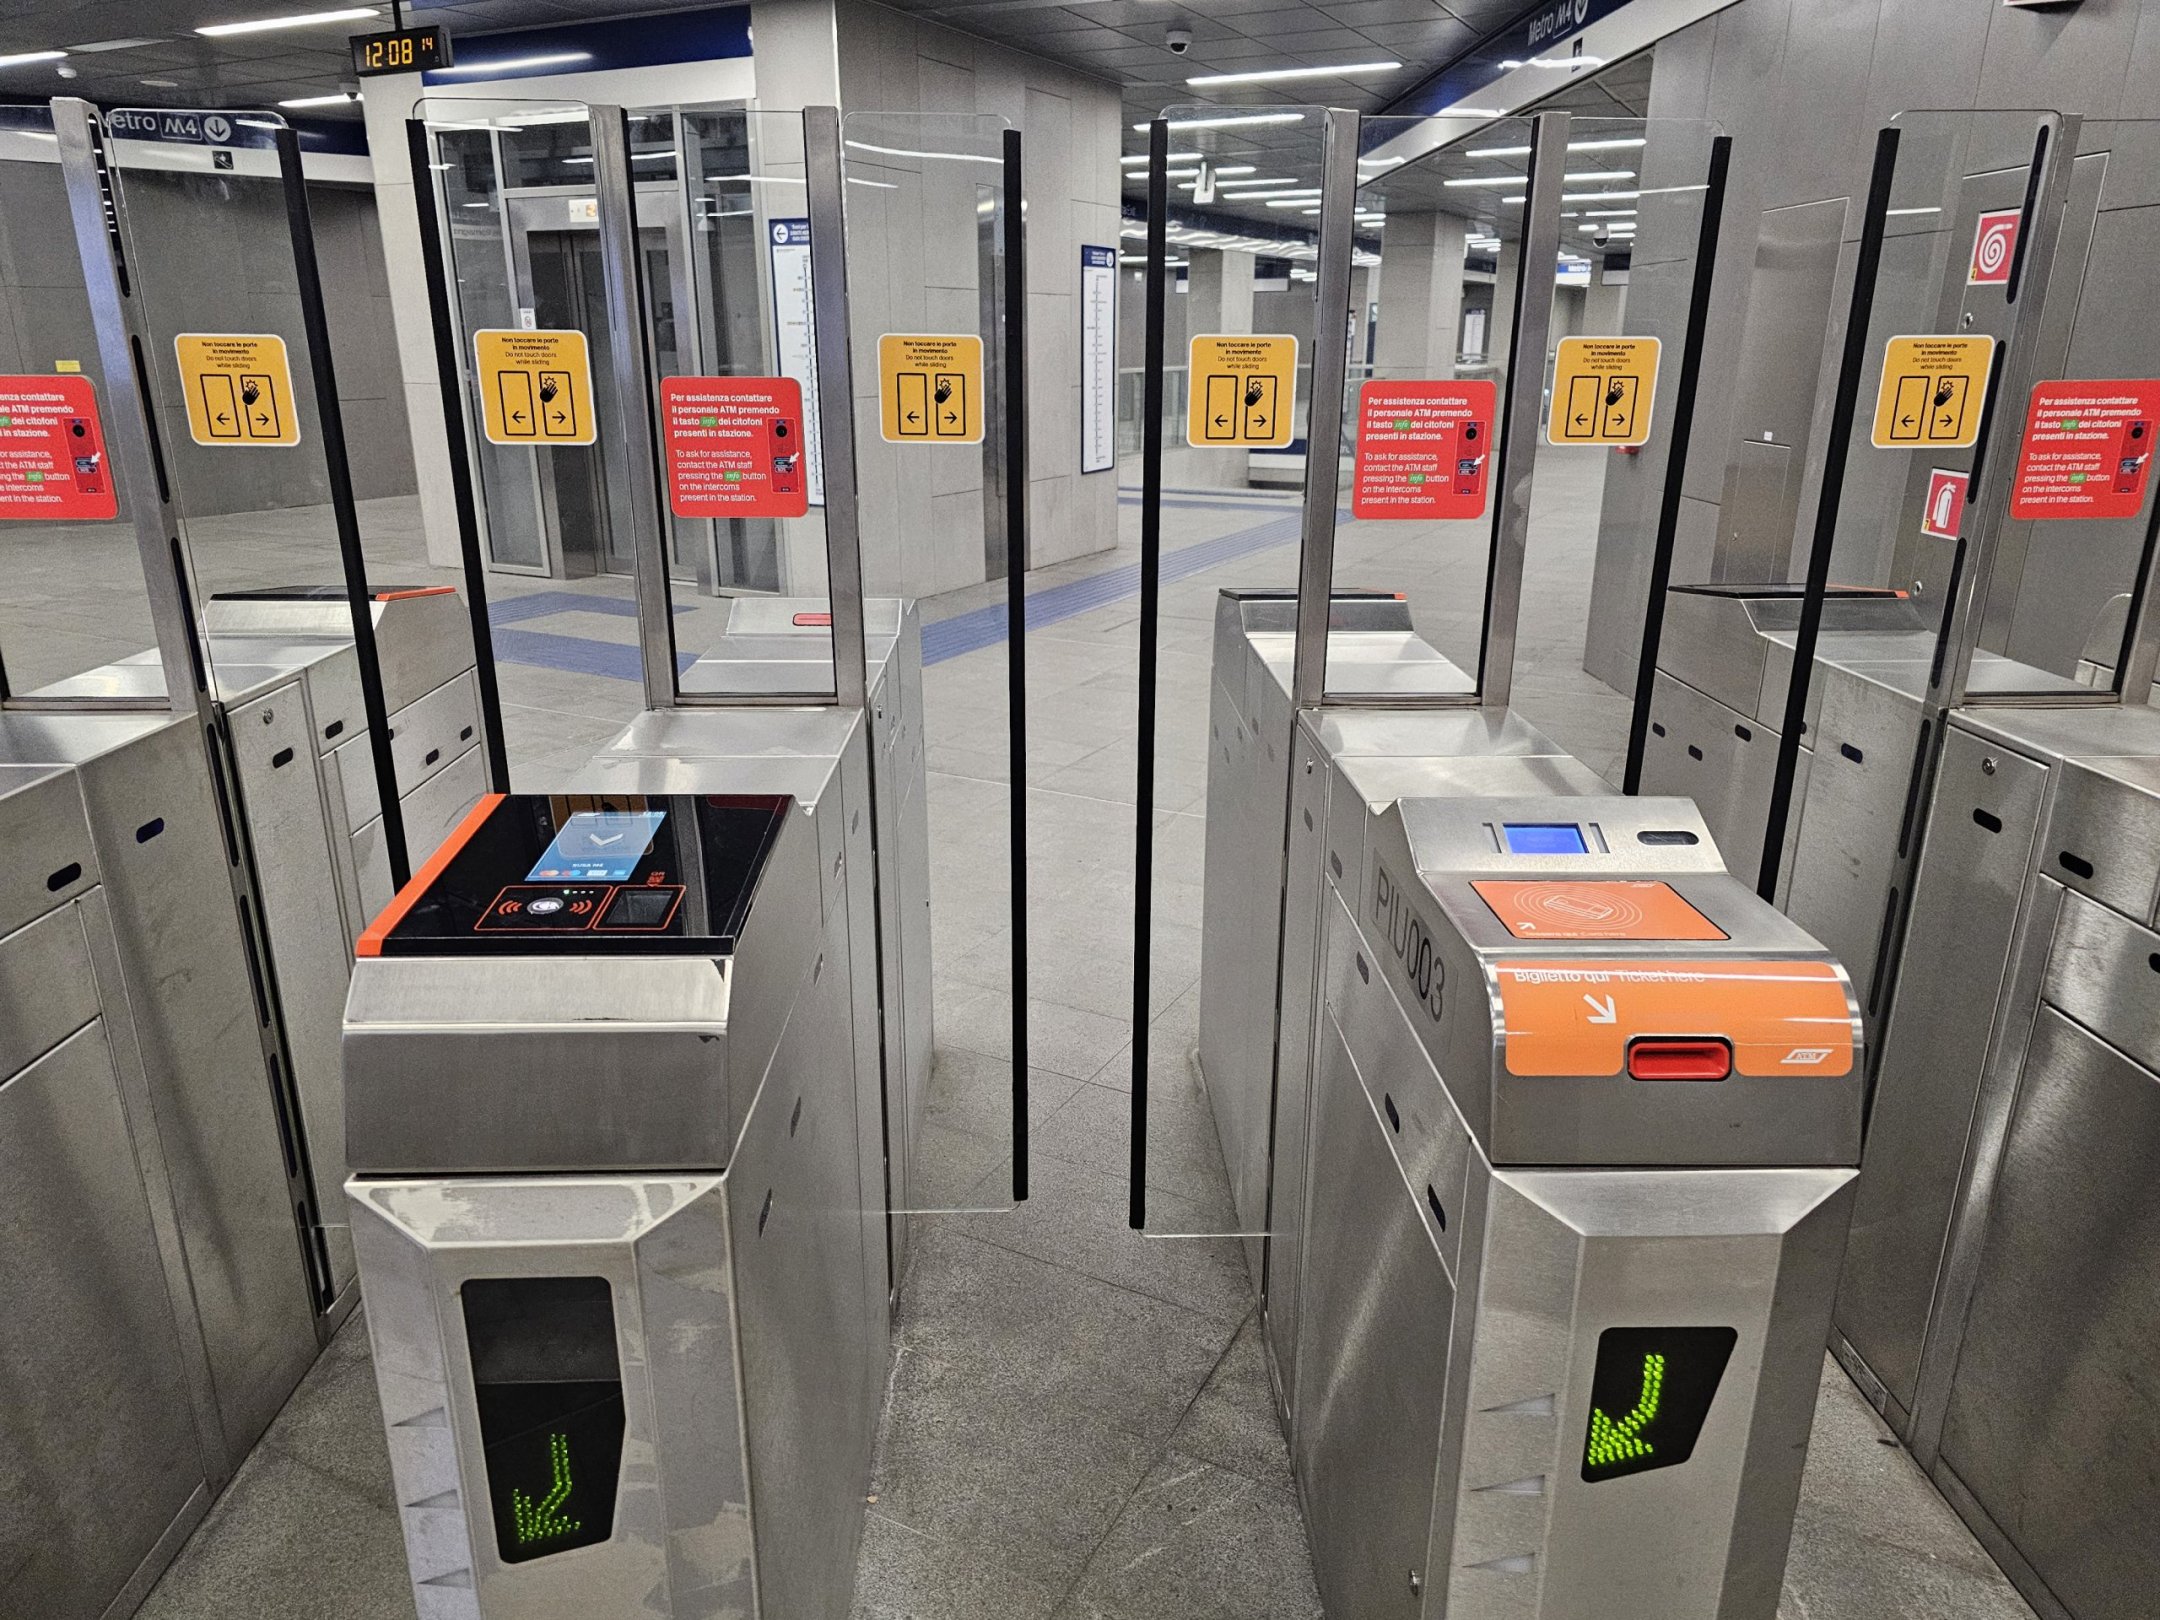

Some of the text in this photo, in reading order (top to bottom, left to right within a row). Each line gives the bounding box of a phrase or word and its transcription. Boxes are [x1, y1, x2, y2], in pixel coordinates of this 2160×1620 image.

[1528, 12, 1554, 46] Metro
[422, 37, 433, 51] 14
[164, 118, 197, 135] M4
[21, 393, 65, 401] contattare
[671, 393, 772, 402] Per assistenza contattare
[1368, 397, 1467, 406] Per assistenza contattare
[2039, 397, 2139, 406] Per assistenza contattare
[12, 405, 29, 413] ATM
[31, 405, 74, 414] premendo
[678, 406, 718, 414] personale
[738, 406, 779, 414] premendo
[1373, 409, 1413, 418] personale
[1413, 409, 1431, 417] ATM
[1432, 409, 1472, 418] premendo
[2037, 409, 2042, 417] il
[2042, 409, 2082, 418] personale
[2100, 409, 2142, 418] premendo
[732, 418, 762, 426] citofoni
[1410, 421, 1422, 429] dei
[1424, 421, 1454, 429] citofoni
[2092, 420, 2122, 428] citofoni
[4, 429, 50, 437] in stazione.
[674, 429, 707, 438] presenti
[1366, 432, 1398, 441] presenti
[1400, 432, 1407, 440] in
[2032, 432, 2065, 442] presenti
[2066, 432, 2073, 440] in
[676, 450, 752, 459] To ask for assistance,
[1399, 453, 1438, 462] assistance,
[2062, 453, 2102, 461] assistance,
[2067, 463, 2083, 471] ATM
[2084, 463, 2100, 471] staff
[678, 472, 710, 481] pressing
[1363, 475, 1394, 483] pressing
[2024, 475, 2055, 483] pressing
[2046, 485, 2081, 493] intercoms
[680, 494, 708, 502] present
[1361, 497, 1389, 505] present
[2020, 496, 2048, 505] present
[1375, 866, 1445, 1022] PIU003
[1514, 968, 1705, 984] Biglietto qui Ticket here
